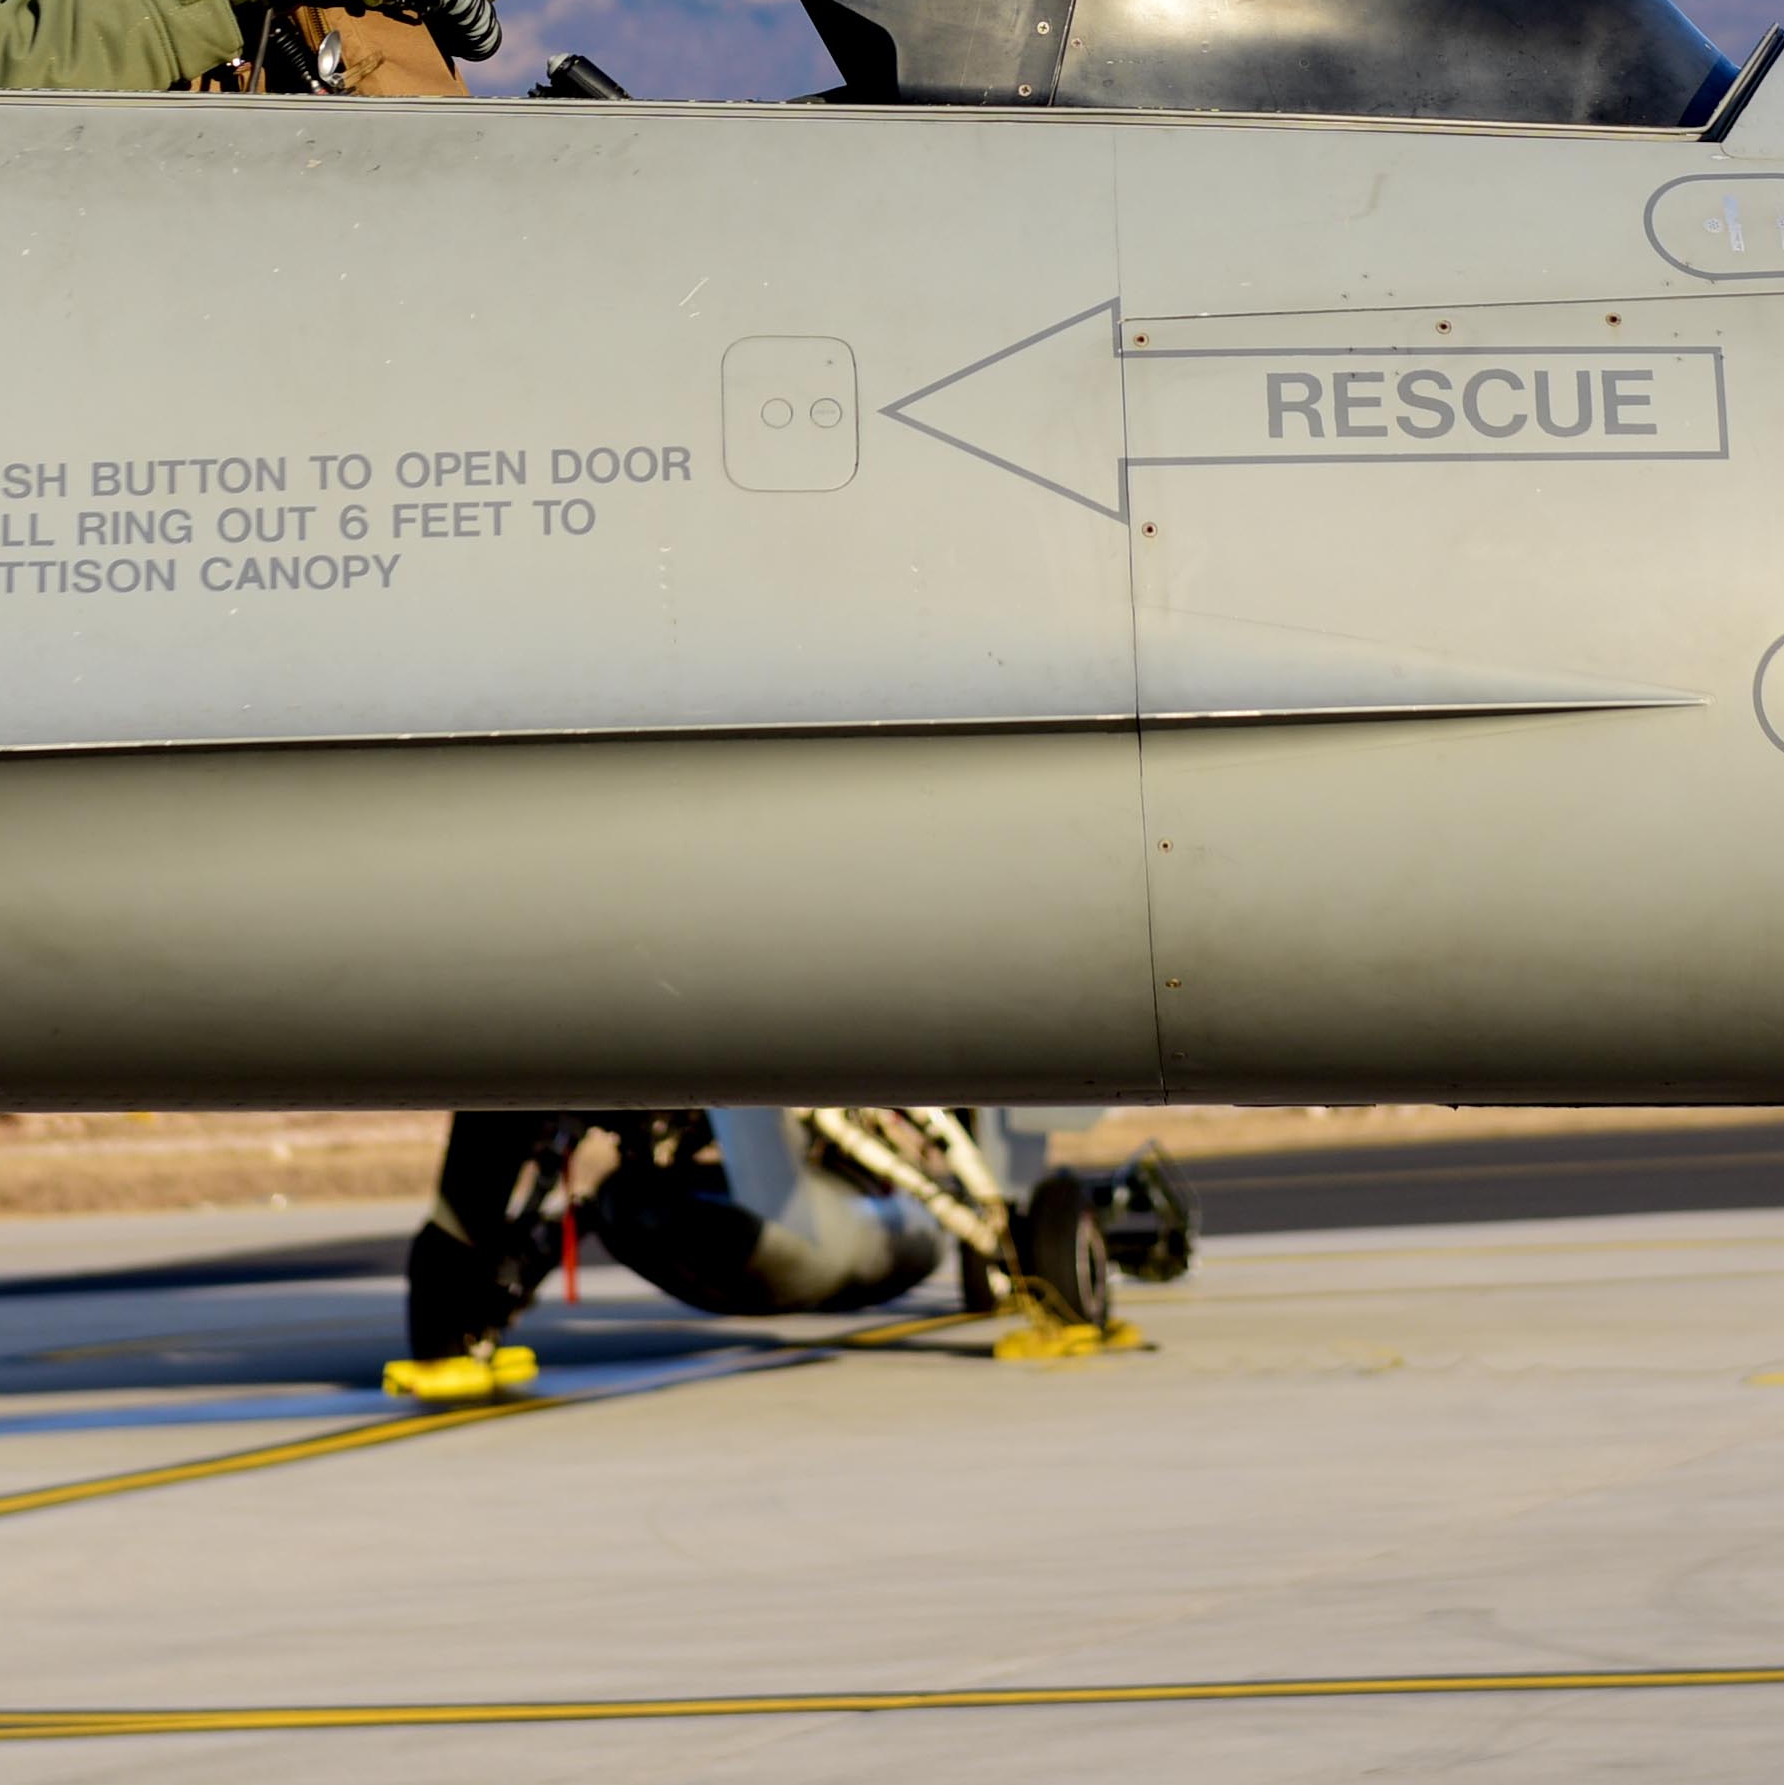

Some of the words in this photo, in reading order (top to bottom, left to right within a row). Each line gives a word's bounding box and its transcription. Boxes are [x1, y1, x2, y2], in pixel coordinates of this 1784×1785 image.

[1266, 368, 1659, 441] RESCUE
[91, 457, 288, 498] BUTTON
[308, 454, 374, 492] TO
[396, 450, 528, 490] OPEN
[551, 446, 693, 486] DOOR
[78, 509, 195, 548] RING
[217, 506, 319, 545] OUT
[339, 504, 371, 542] 6
[392, 501, 513, 541] FEET
[532, 498, 598, 538] TO
[199, 554, 403, 594] CANOPY
